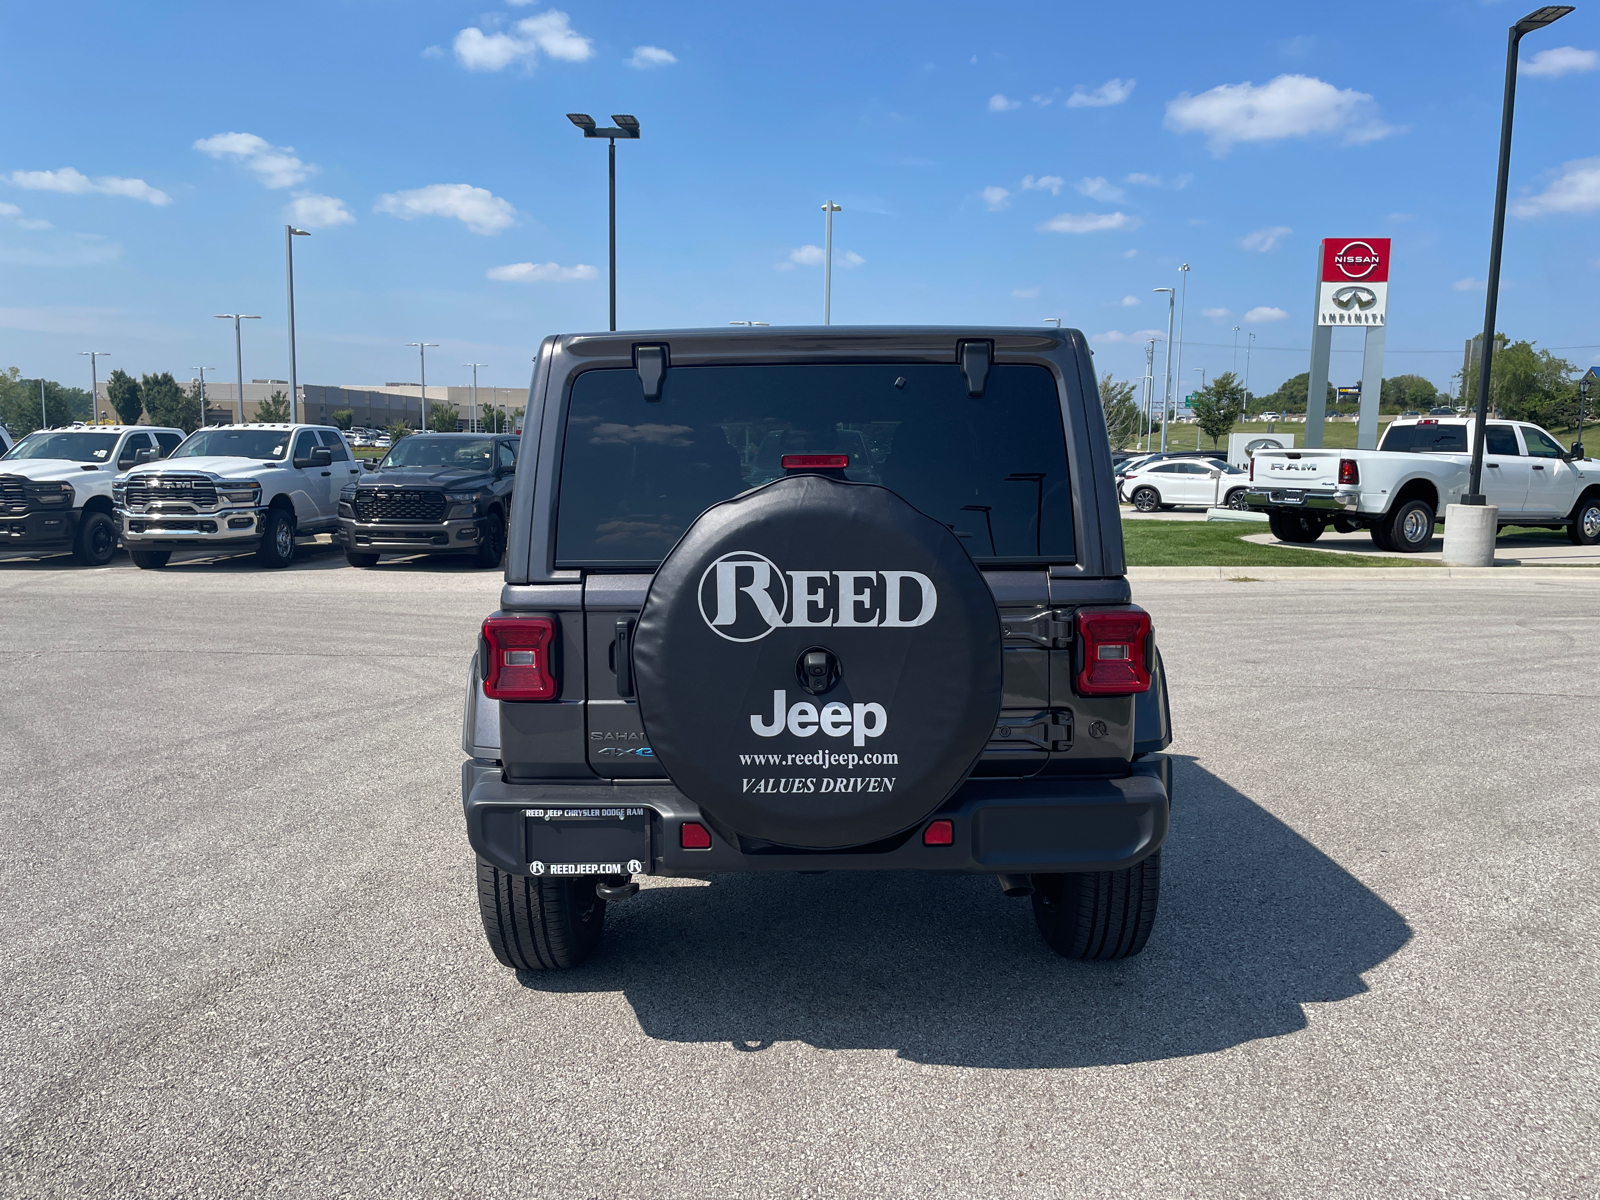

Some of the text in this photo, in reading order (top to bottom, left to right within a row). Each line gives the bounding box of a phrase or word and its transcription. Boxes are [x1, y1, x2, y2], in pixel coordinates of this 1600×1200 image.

[1322, 313, 1384, 324] INFINITI
[1270, 463, 1318, 471] RAM
[705, 556, 938, 633] REED
[750, 689, 888, 746] Jeep
[739, 749, 899, 769] www.reedjeep.com
[741, 777, 897, 794] VALUES DRIVEN
[526, 808, 644, 817] REED JEEP CHRYSLER DODGE RAM
[550, 863, 621, 875] REEDJEEP.COM
